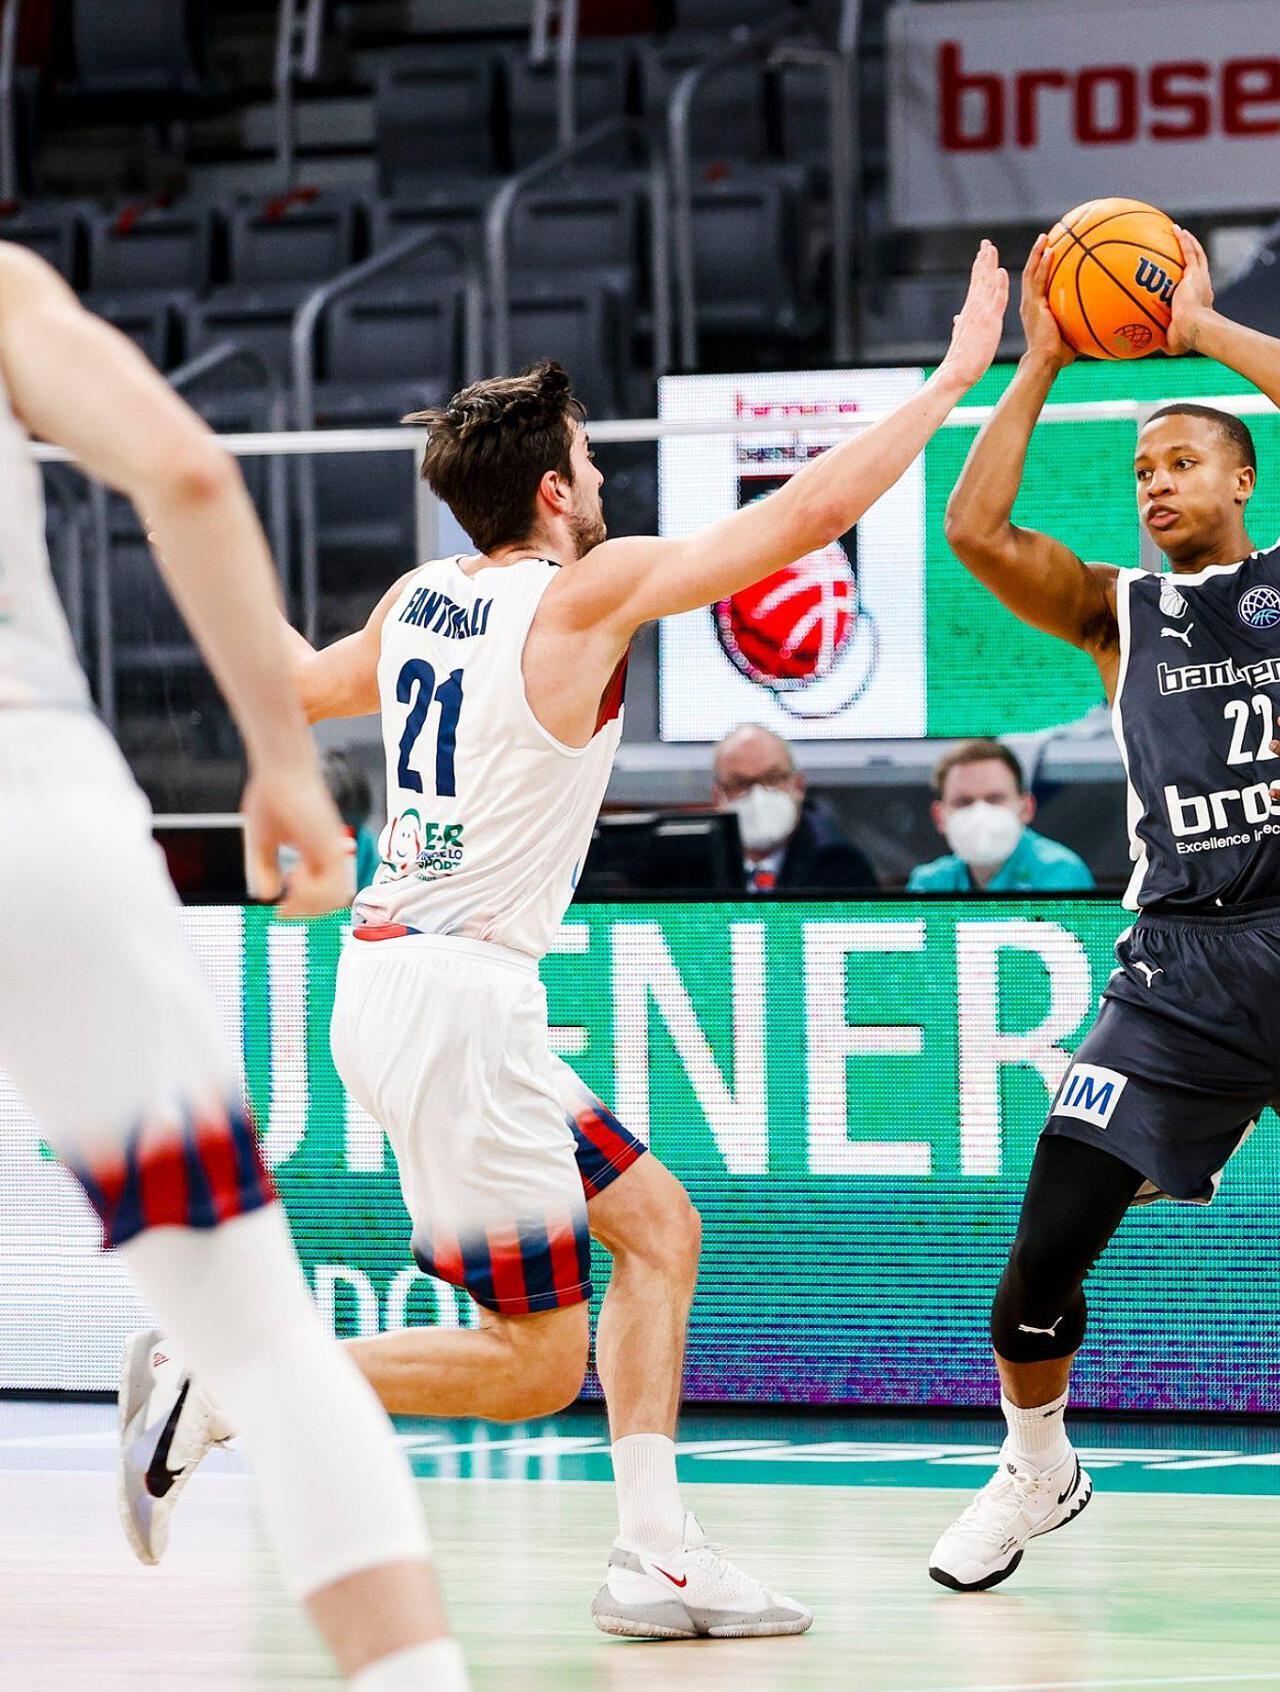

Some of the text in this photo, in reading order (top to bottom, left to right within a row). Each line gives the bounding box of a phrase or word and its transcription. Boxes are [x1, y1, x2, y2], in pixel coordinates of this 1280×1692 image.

[396, 658, 464, 797] 21
[1223, 694, 1280, 765] 22
[1176, 831, 1251, 854] Excellence
[1062, 1075, 1115, 1116] IM
